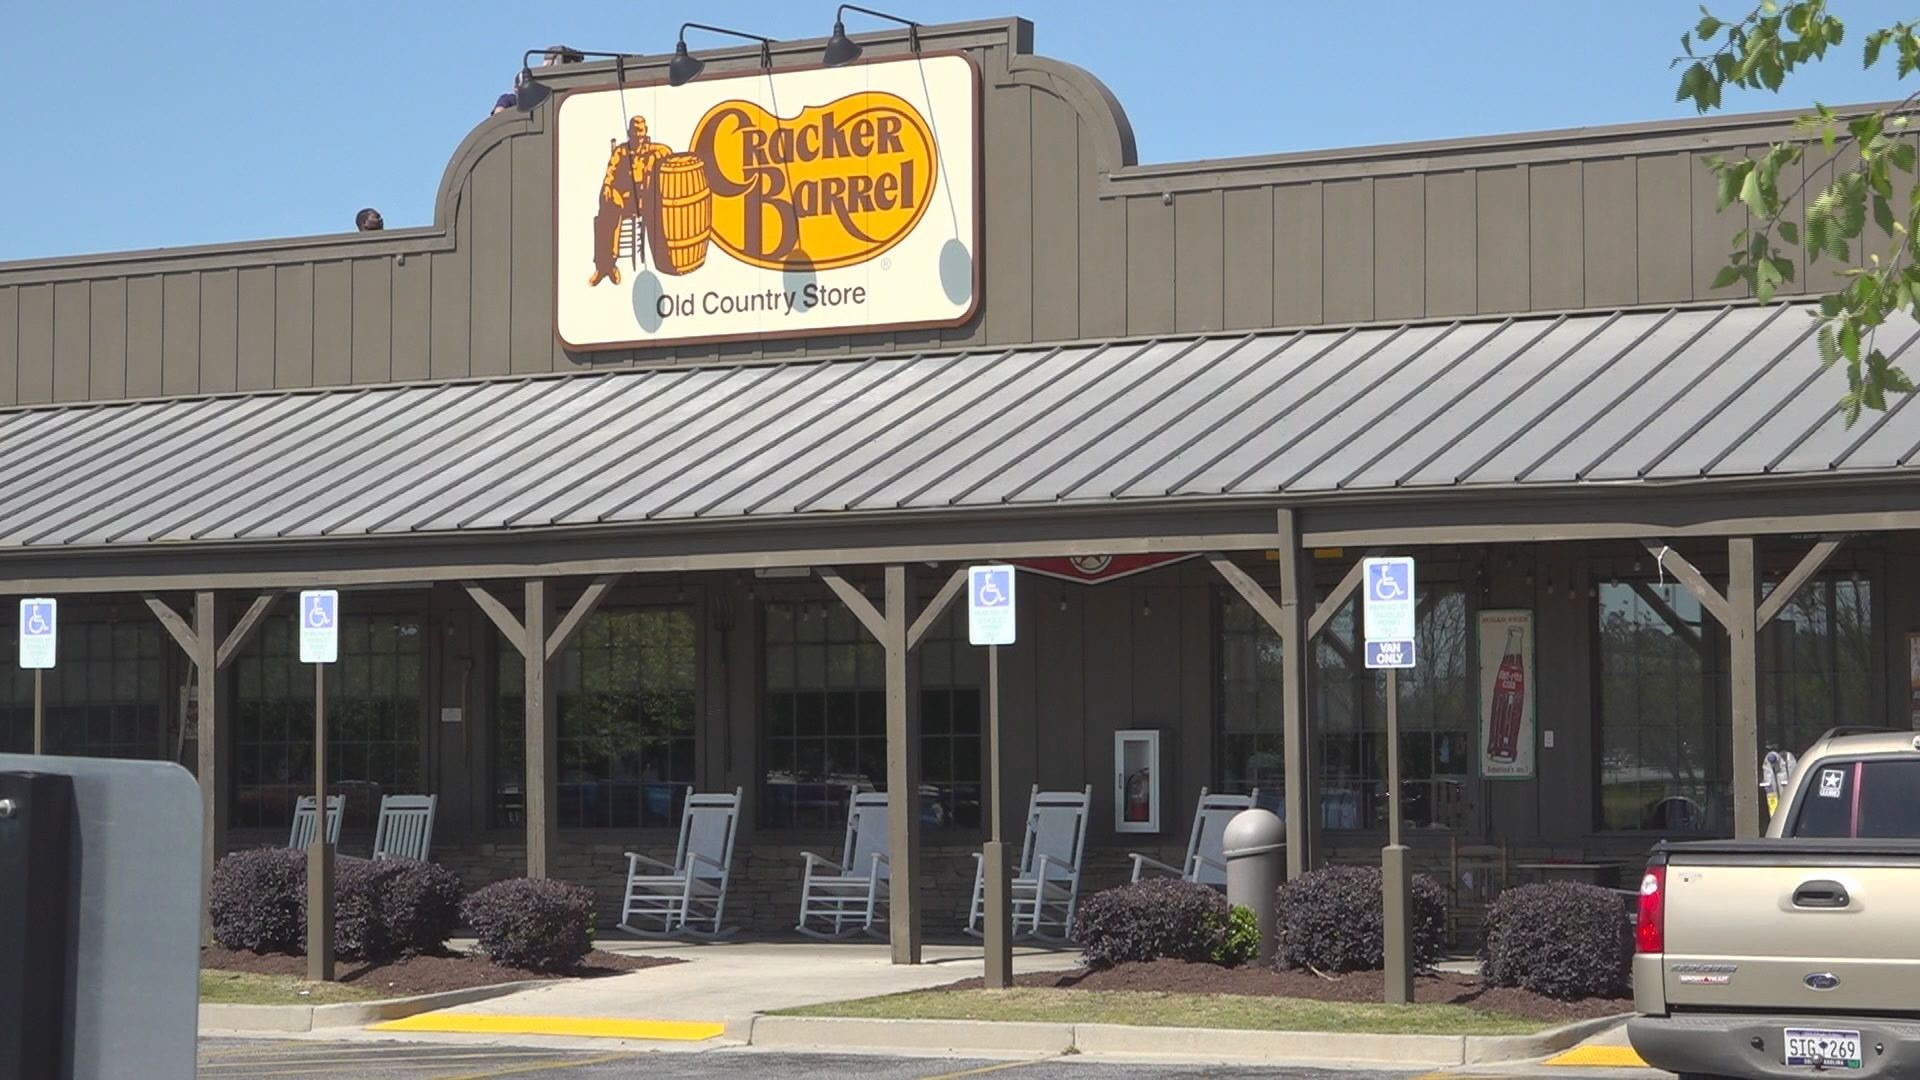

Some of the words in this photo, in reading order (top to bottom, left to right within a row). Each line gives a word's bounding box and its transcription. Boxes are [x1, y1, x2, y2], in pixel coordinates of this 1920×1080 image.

[656, 291, 695, 319] Old
[702, 288, 797, 317] Country
[802, 283, 867, 309] Store
[1379, 641, 1401, 653] VAN
[1376, 652, 1404, 665] ONLY
[1789, 1038, 1816, 1057] SIG
[1829, 1039, 1856, 1058] 269
